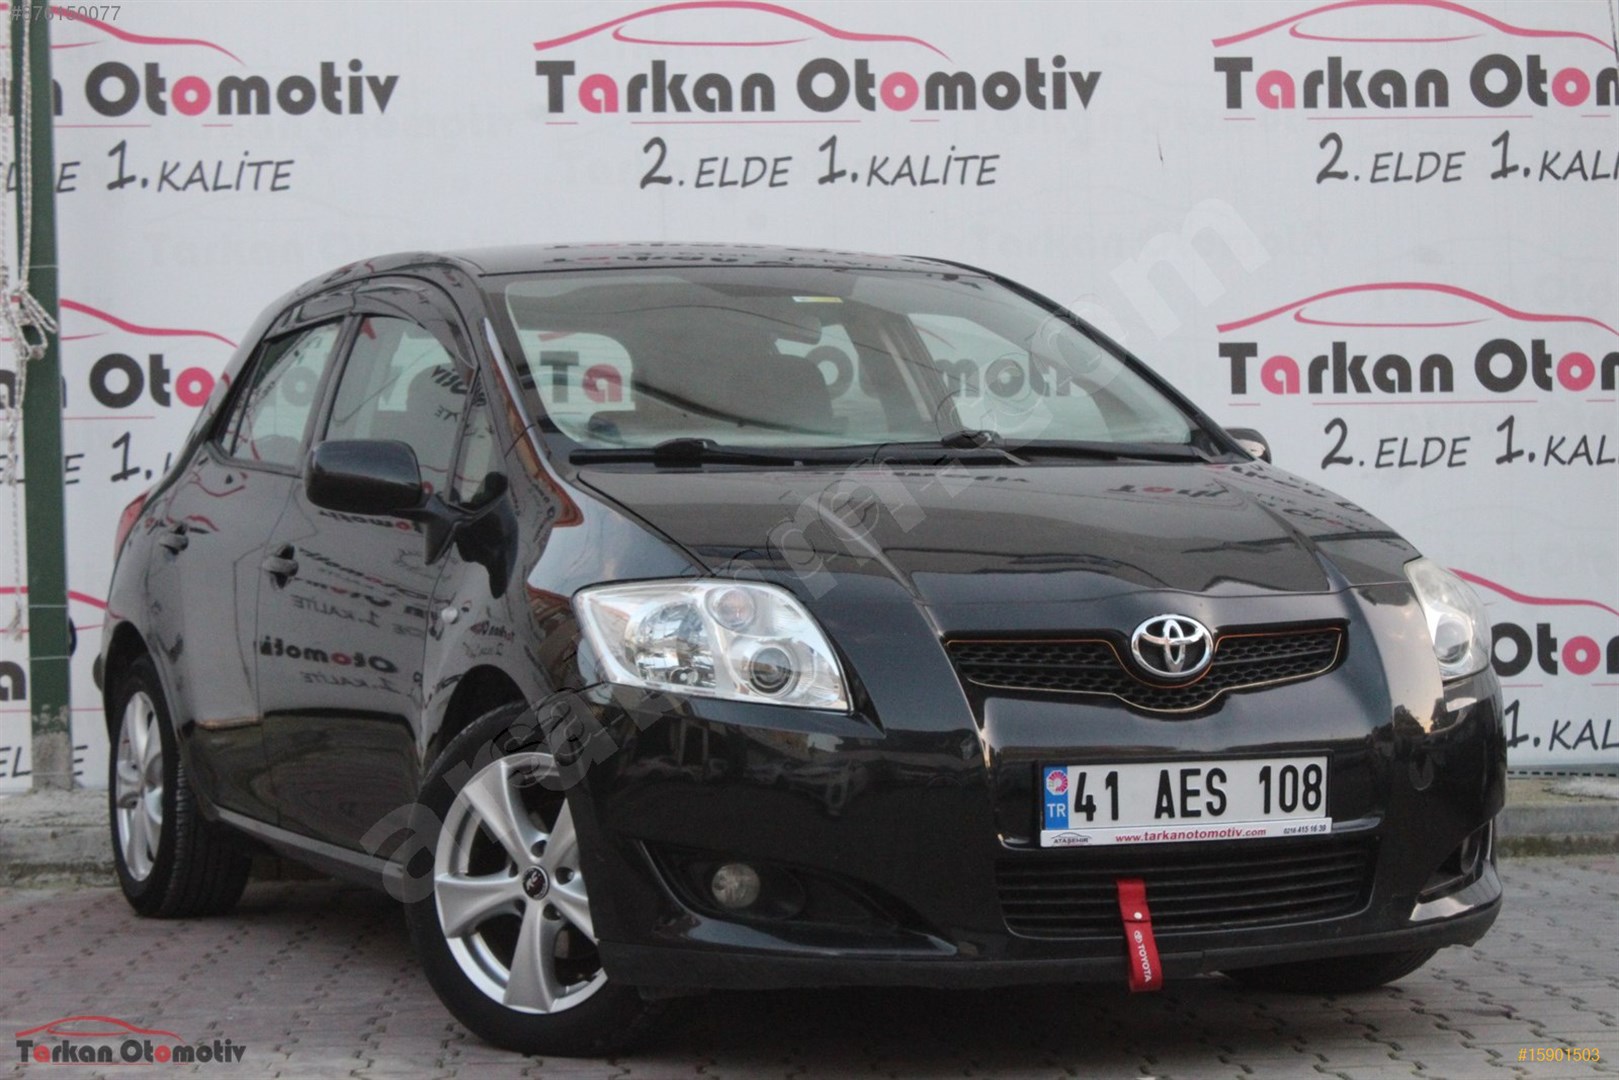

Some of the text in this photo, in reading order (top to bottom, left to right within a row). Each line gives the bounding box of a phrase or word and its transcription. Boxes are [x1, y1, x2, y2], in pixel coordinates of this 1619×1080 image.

[85, 59, 398, 117] Otomotiv
[536, 55, 1101, 113] Tarkan Otomotiv
[1214, 57, 1448, 109] Tarkan
[1219, 342, 1454, 394] Tarkan
[1491, 622, 1619, 677] Oto
[1047, 803, 1066, 818] TR
[1074, 764, 1323, 821] 41 AES 108
[1115, 827, 1267, 842] www.tarkanotomotiv.com
[1138, 943, 1152, 982] TOYOTA
